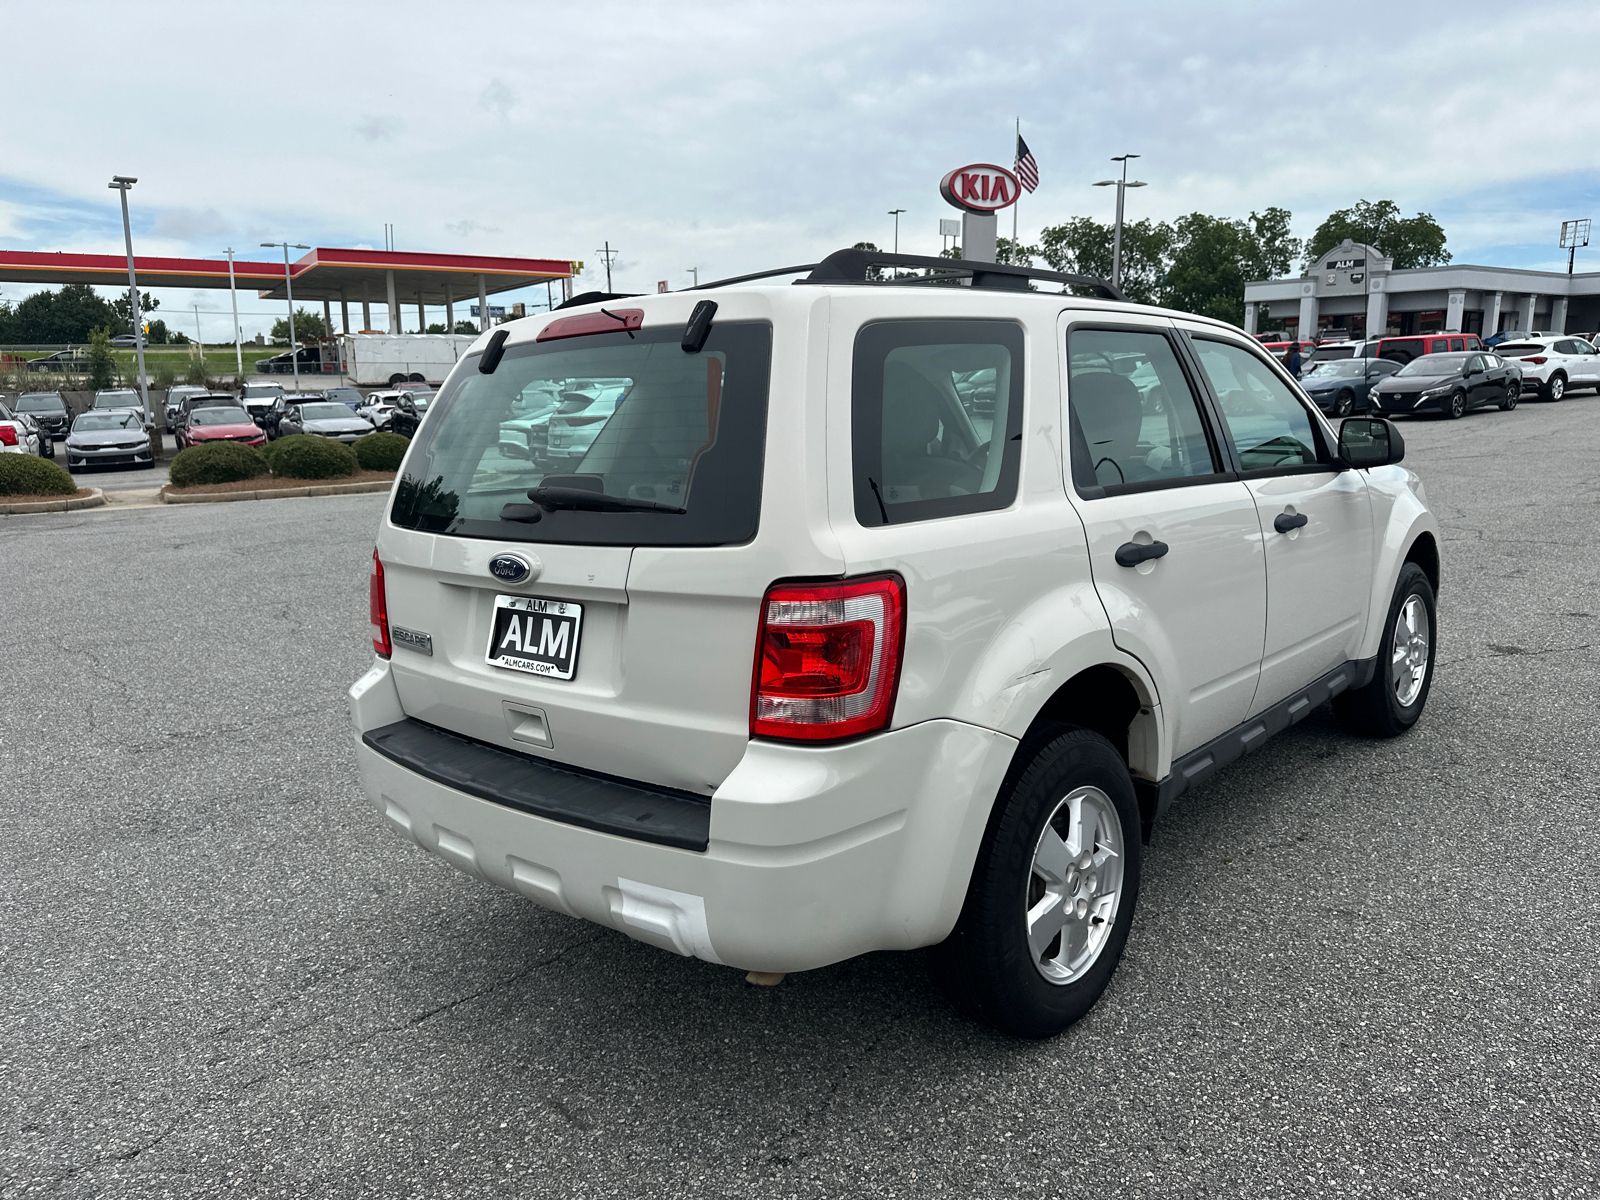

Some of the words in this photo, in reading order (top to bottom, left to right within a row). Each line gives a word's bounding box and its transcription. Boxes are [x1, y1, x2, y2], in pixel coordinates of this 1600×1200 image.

[961, 173, 1009, 202] KIA
[1335, 260, 1354, 269] ALM
[525, 599, 548, 613] ALM
[393, 629, 427, 648] ESCAPE
[500, 613, 571, 660] ALM
[504, 657, 552, 674] ALMCARS.COM
